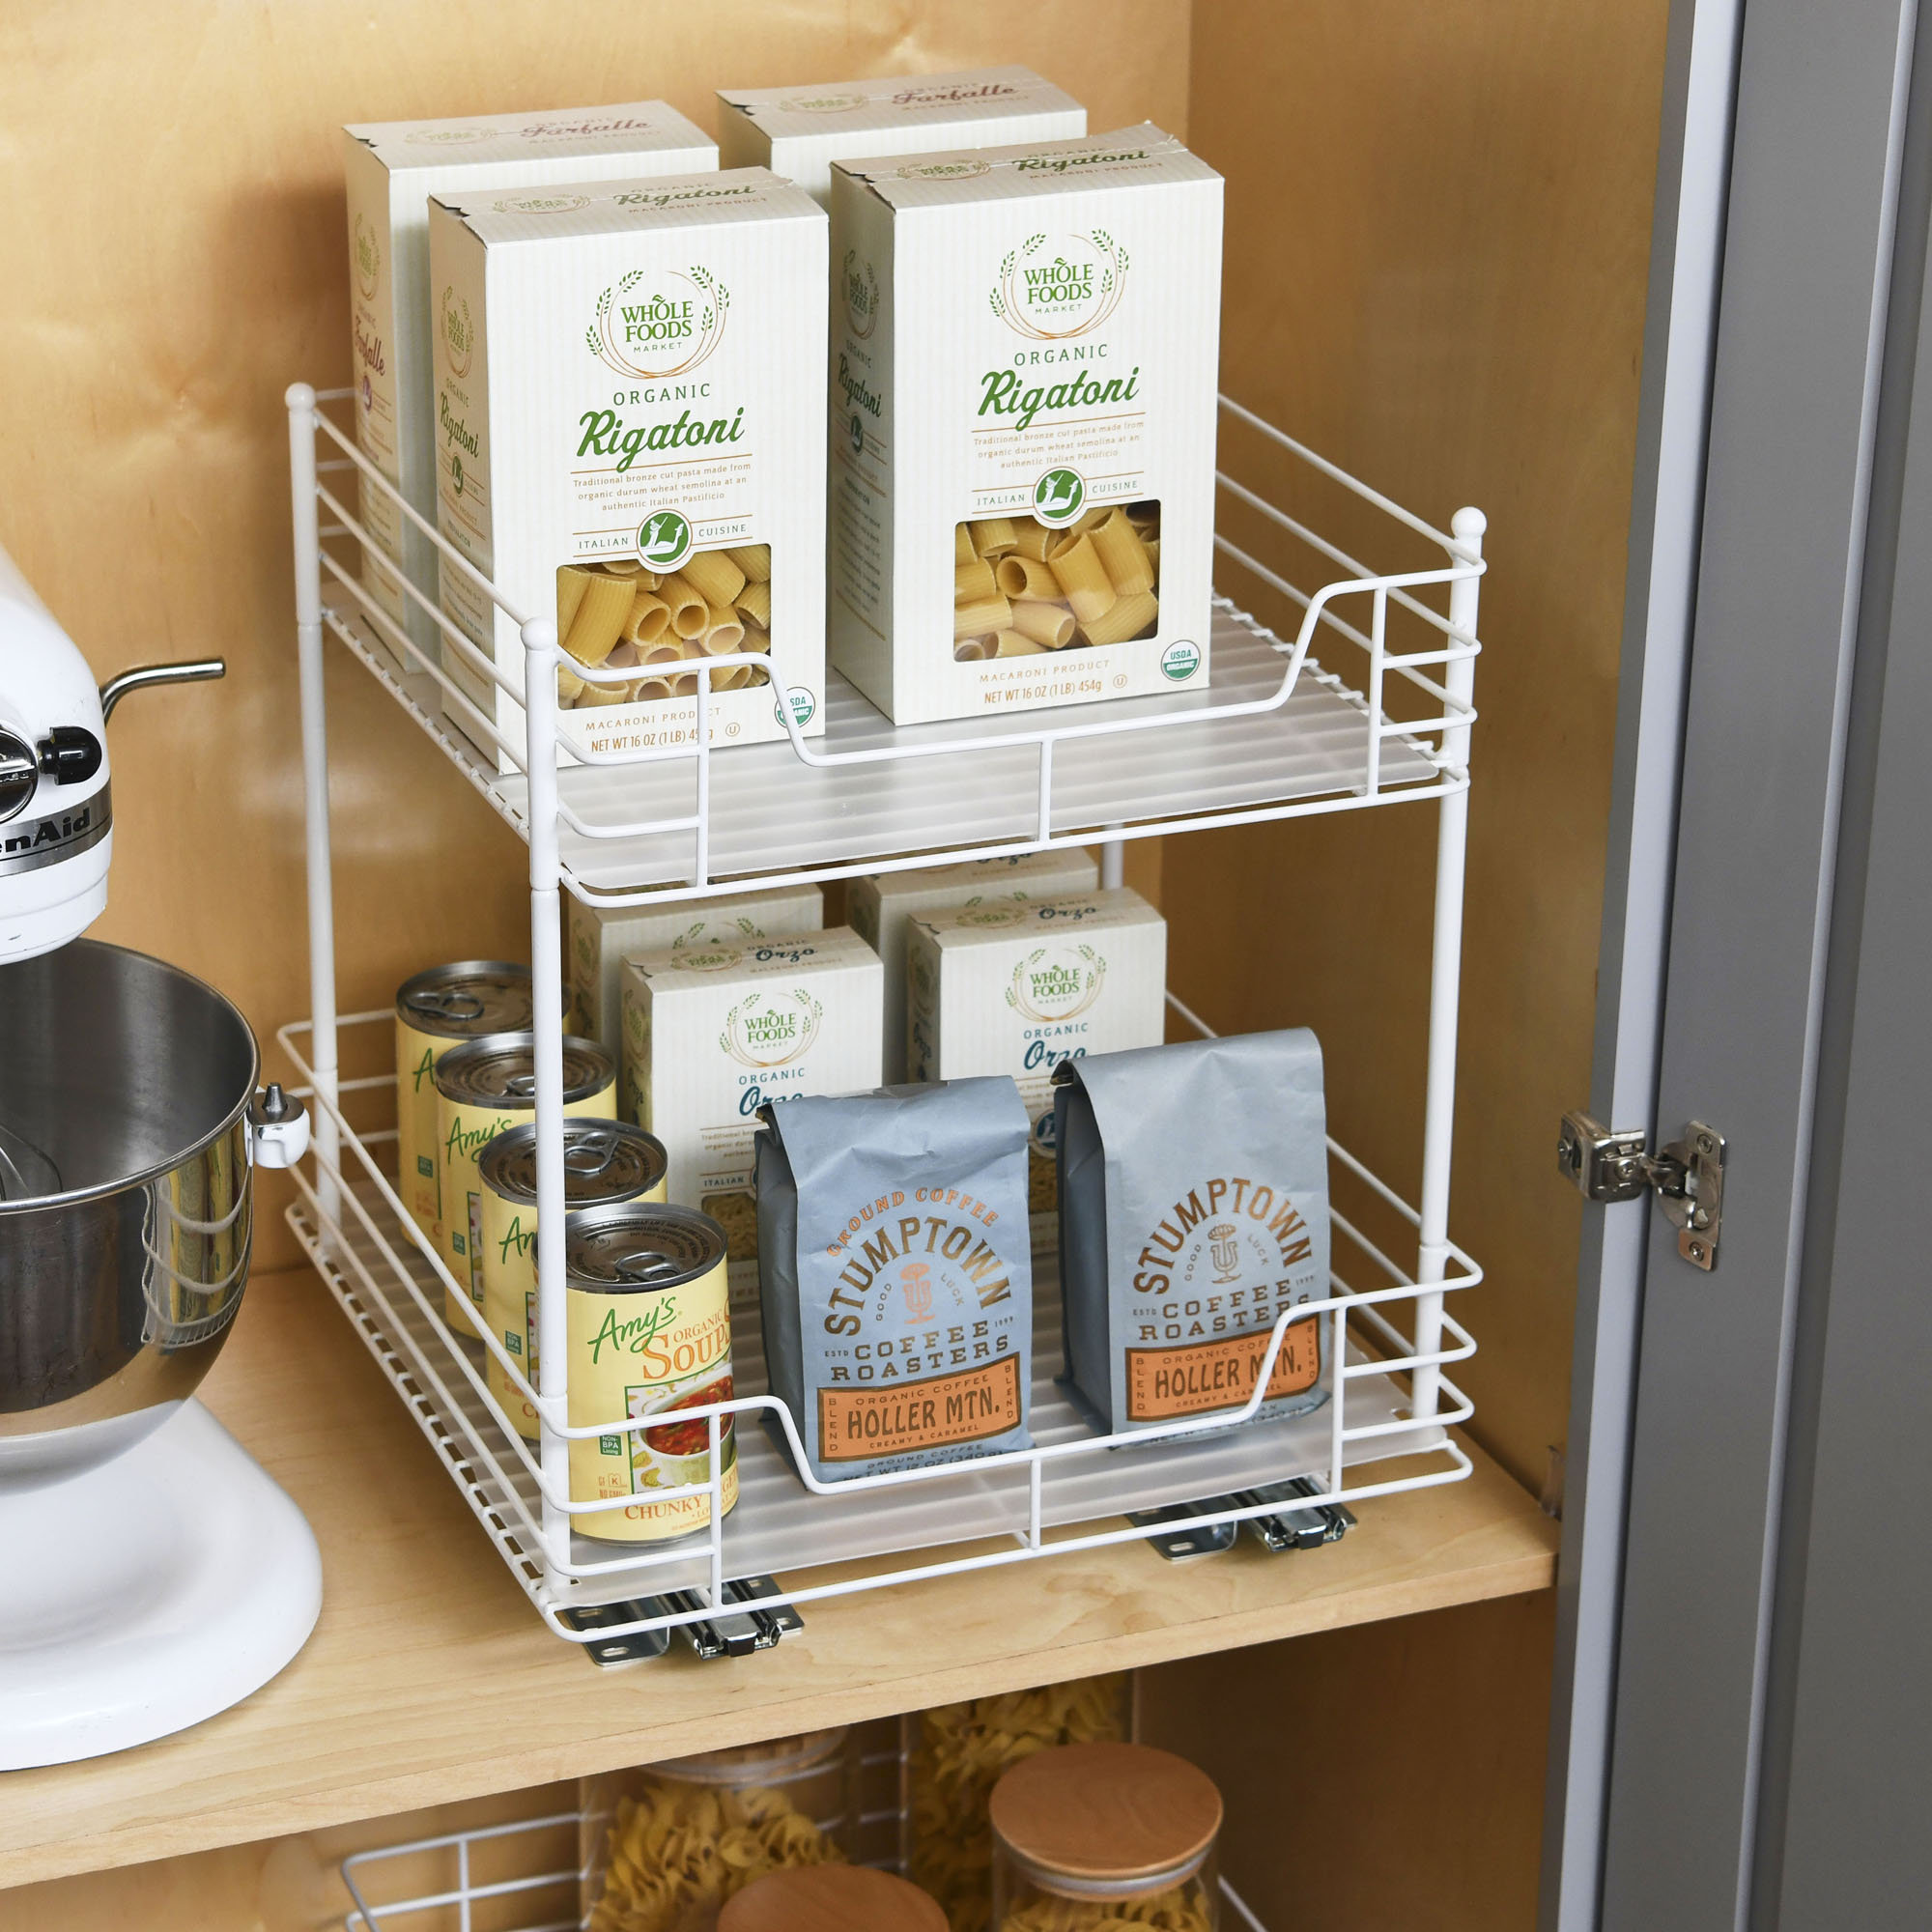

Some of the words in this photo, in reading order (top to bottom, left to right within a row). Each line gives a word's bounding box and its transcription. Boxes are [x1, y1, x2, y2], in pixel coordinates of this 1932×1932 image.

[892, 84, 1018, 104] Farfalle
[520, 119, 653, 138] Farfalle
[1012, 151, 1151, 172] Rigatoni
[612, 185, 756, 207] Rigatoni
[1024, 264, 1094, 286] WHOLE
[1027, 282, 1093, 305] FOODS
[620, 300, 695, 325] WHOLE
[1035, 303, 1083, 315] MARKET
[625, 320, 693, 343] FOODS
[633, 341, 683, 354] MARKET
[1014, 344, 1108, 366] ORGANIC
[613, 384, 711, 406] ORGANIC
[838, 352, 882, 418] Rigatoni
[978, 366, 1140, 431] Rigatoni
[440, 392, 480, 459] Rigatoni
[974, 434, 1022, 446] Traditional
[1024, 431, 1054, 441] bronze
[1057, 430, 1070, 439] cut
[1073, 427, 1096, 438] pasta
[1098, 423, 1122, 433] made
[1123, 420, 1145, 431] from
[577, 407, 746, 474] Rigatoni
[978, 447, 1012, 459] organic
[1015, 444, 1044, 455] durum
[1047, 441, 1074, 451] wheat
[1077, 436, 1116, 448] semolina
[1001, 458, 1043, 469] authentic
[1046, 454, 1075, 465] Italian
[1077, 449, 1119, 461] Pastificio
[573, 474, 623, 488] Traditional
[626, 471, 657, 483] bronze
[660, 471, 674, 480] cut
[677, 468, 701, 480] pasta
[703, 464, 728, 475] made
[729, 462, 752, 472] from
[578, 490, 613, 501] organic
[616, 486, 648, 497] durum
[650, 483, 678, 494] wheat
[681, 478, 722, 491] semolina
[724, 477, 734, 486] at
[978, 494, 1026, 506] ITALIAN
[1092, 480, 1138, 494] CUISINE
[602, 500, 646, 512] authentic
[649, 497, 679, 507] Italian
[682, 492, 725, 504] Pastificio
[579, 537, 629, 550] ITALIAN
[698, 524, 747, 537] CUISINE
[1170, 649, 1192, 660] USDA
[980, 668, 1047, 683] MACARONI
[1054, 660, 1111, 674] PRODUCT
[984, 690, 1002, 704] NET
[1006, 688, 1020, 702] WT
[1022, 687, 1032, 699] 16
[1035, 685, 1047, 698] OZ
[1049, 683, 1058, 696] (1
[1061, 682, 1076, 696] LB)
[1078, 680, 1103, 694] 454g
[585, 715, 655, 731] MACARONI
[662, 707, 721, 721] PRODCT
[591, 739, 610, 753] NET
[612, 736, 628, 750] WT
[631, 735, 640, 748] 16
[643, 733, 656, 746] OZ
[659, 731, 668, 746] (1
[670, 729, 686, 743] LB)
[689, 728, 713, 742] 45g
[0, 807, 91, 853] nAid
[1037, 905, 1097, 921] Orzo
[755, 946, 818, 962] Orzo
[1030, 968, 1081, 985] WHOLE
[1033, 980, 1080, 998] FOODS
[744, 1013, 797, 1031] WHOLE
[1023, 1022, 1089, 1039] ORGANIC
[748, 1026, 796, 1044] FOODS
[739, 1067, 806, 1086] ORGANIC
[704, 1176, 744, 1187] ITALIAN
[826, 1191, 905, 1256] GROUND
[916, 1187, 999, 1227] COFFEE
[1132, 1178, 1313, 1295] STUMPTOWN
[1184, 1243, 1202, 1282] GOOD
[1246, 1234, 1270, 1266] LUCK
[824, 1216, 1011, 1337] STUMPTOWN
[875, 1283, 892, 1321] GOOD
[941, 1272, 964, 1306] LUCK
[1162, 1279, 1291, 1320] COFFEE
[587, 1296, 677, 1365] Amy's
[673, 1309, 723, 1344] ORGANIC
[854, 1321, 989, 1360] COFFEE
[995, 1316, 1013, 1327] 1999
[831, 1335, 1009, 1381] ROASTERS
[1162, 1348, 1230, 1365] ORGANIC
[855, 1389, 924, 1406] ORGANIC
[933, 1374, 989, 1393] COFFEE
[1136, 1357, 1146, 1410] BLEND
[1154, 1358, 1240, 1400] HOLLER
[1005, 1364, 1014, 1419] BLEND
[1175, 1395, 1217, 1407] CREAMY
[847, 1400, 936, 1439] HOLLER
[946, 1386, 1000, 1424] MTN.
[829, 1398, 838, 1452] BLEND
[869, 1436, 913, 1449] CREAMY
[930, 1424, 980, 1439] CARAMEL
[867, 1454, 924, 1468] GROUND
[930, 1443, 983, 1458] COFFEE
[923, 1458, 946, 1467] OZ
[625, 1493, 703, 1520] CHUNKY
